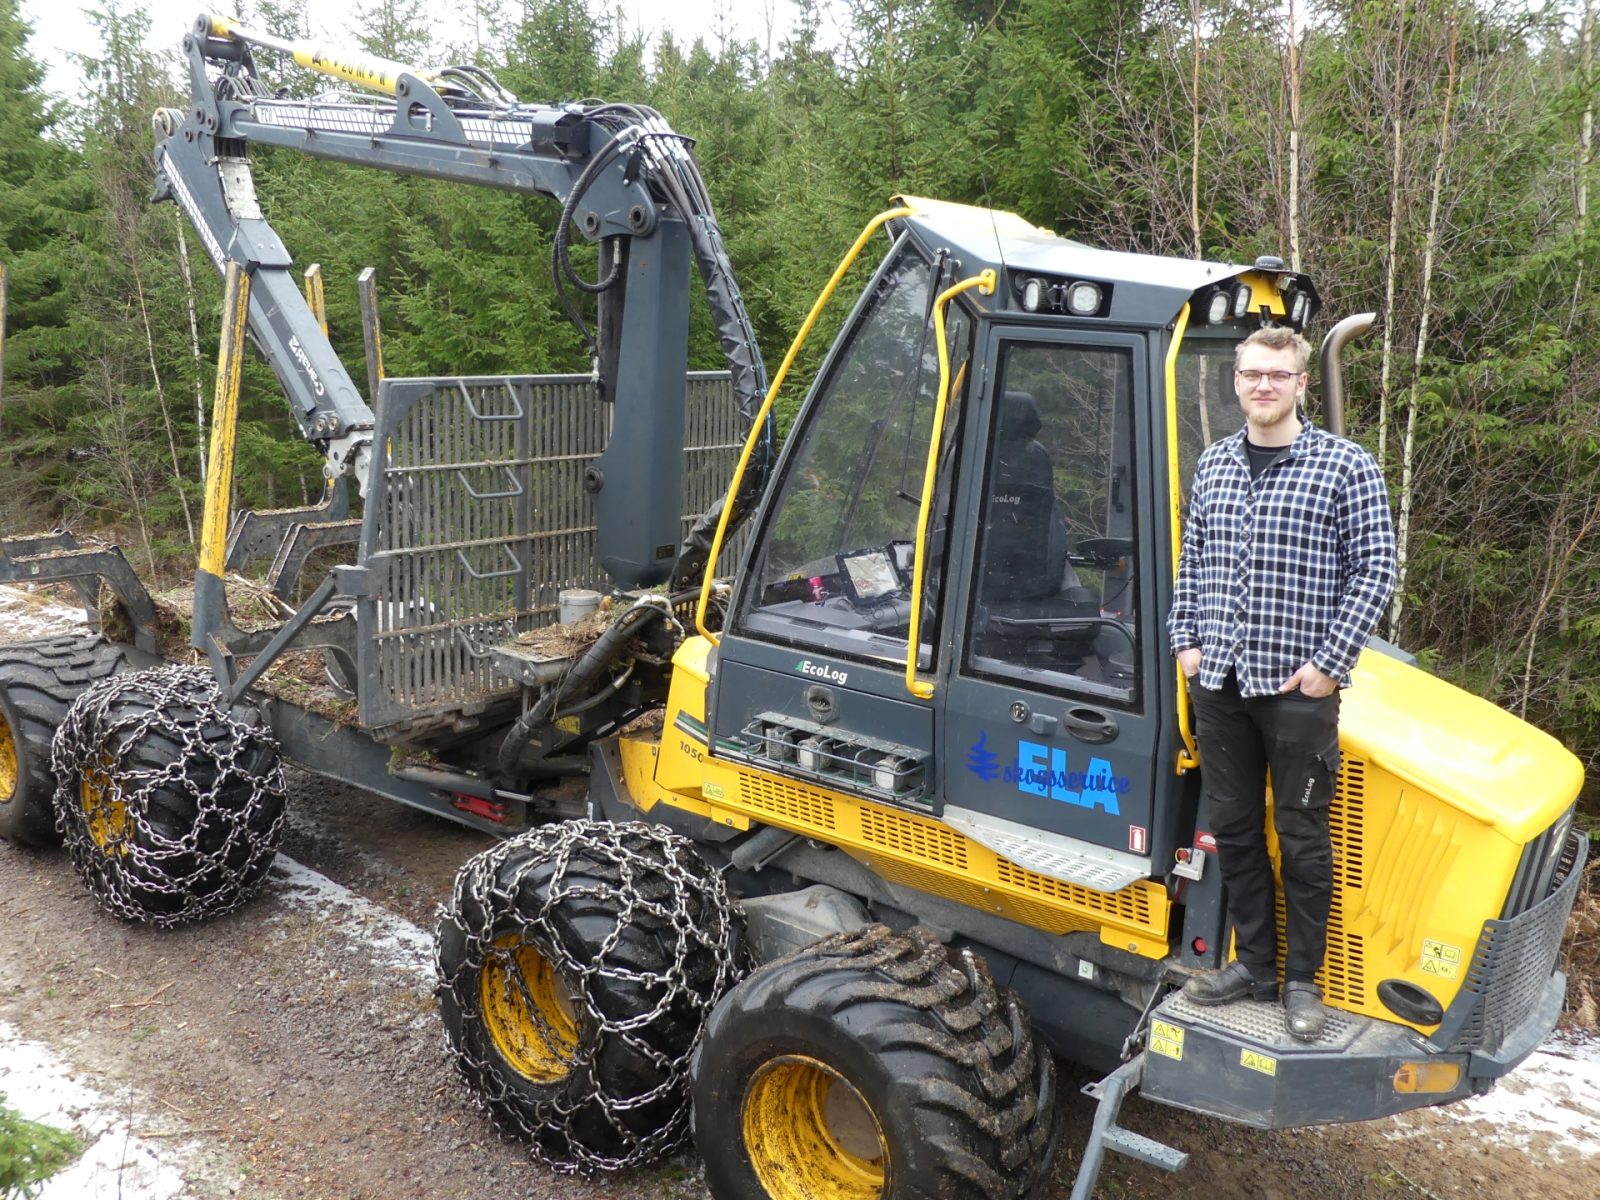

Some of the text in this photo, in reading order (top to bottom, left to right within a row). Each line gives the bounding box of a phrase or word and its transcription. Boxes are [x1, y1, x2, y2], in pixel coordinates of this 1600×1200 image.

[294, 346, 325, 397] Cranab
[801, 660, 848, 685] EcoLog
[679, 740, 704, 763] 1050
[1002, 757, 1131, 795] skogsservice
[1018, 739, 1120, 816] ELA
[1301, 777, 1315, 803] EcoLog
